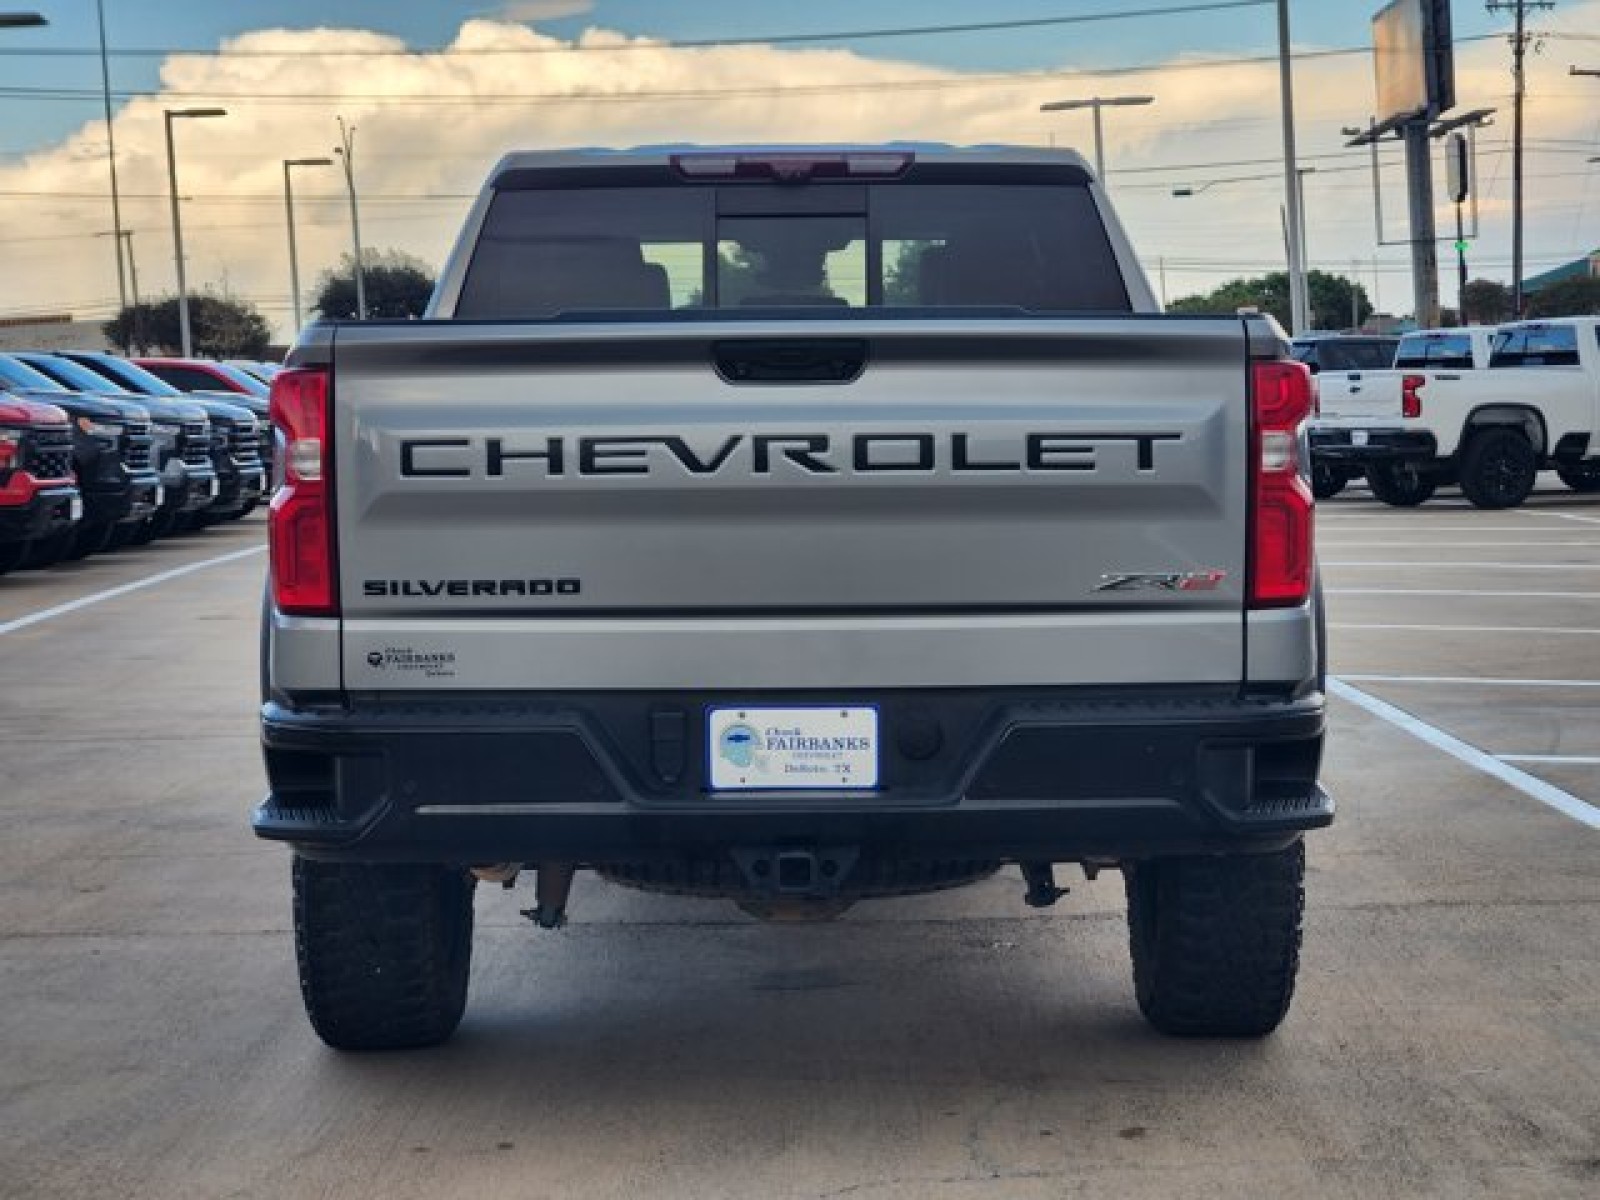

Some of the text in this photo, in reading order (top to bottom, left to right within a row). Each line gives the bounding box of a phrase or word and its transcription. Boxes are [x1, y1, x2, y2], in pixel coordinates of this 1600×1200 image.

[400, 431, 1182, 478] CHEVROLET
[363, 578, 581, 596] SILVERADO
[385, 654, 455, 664] FAIRBANKS
[766, 737, 870, 751] FAIRBANKS
